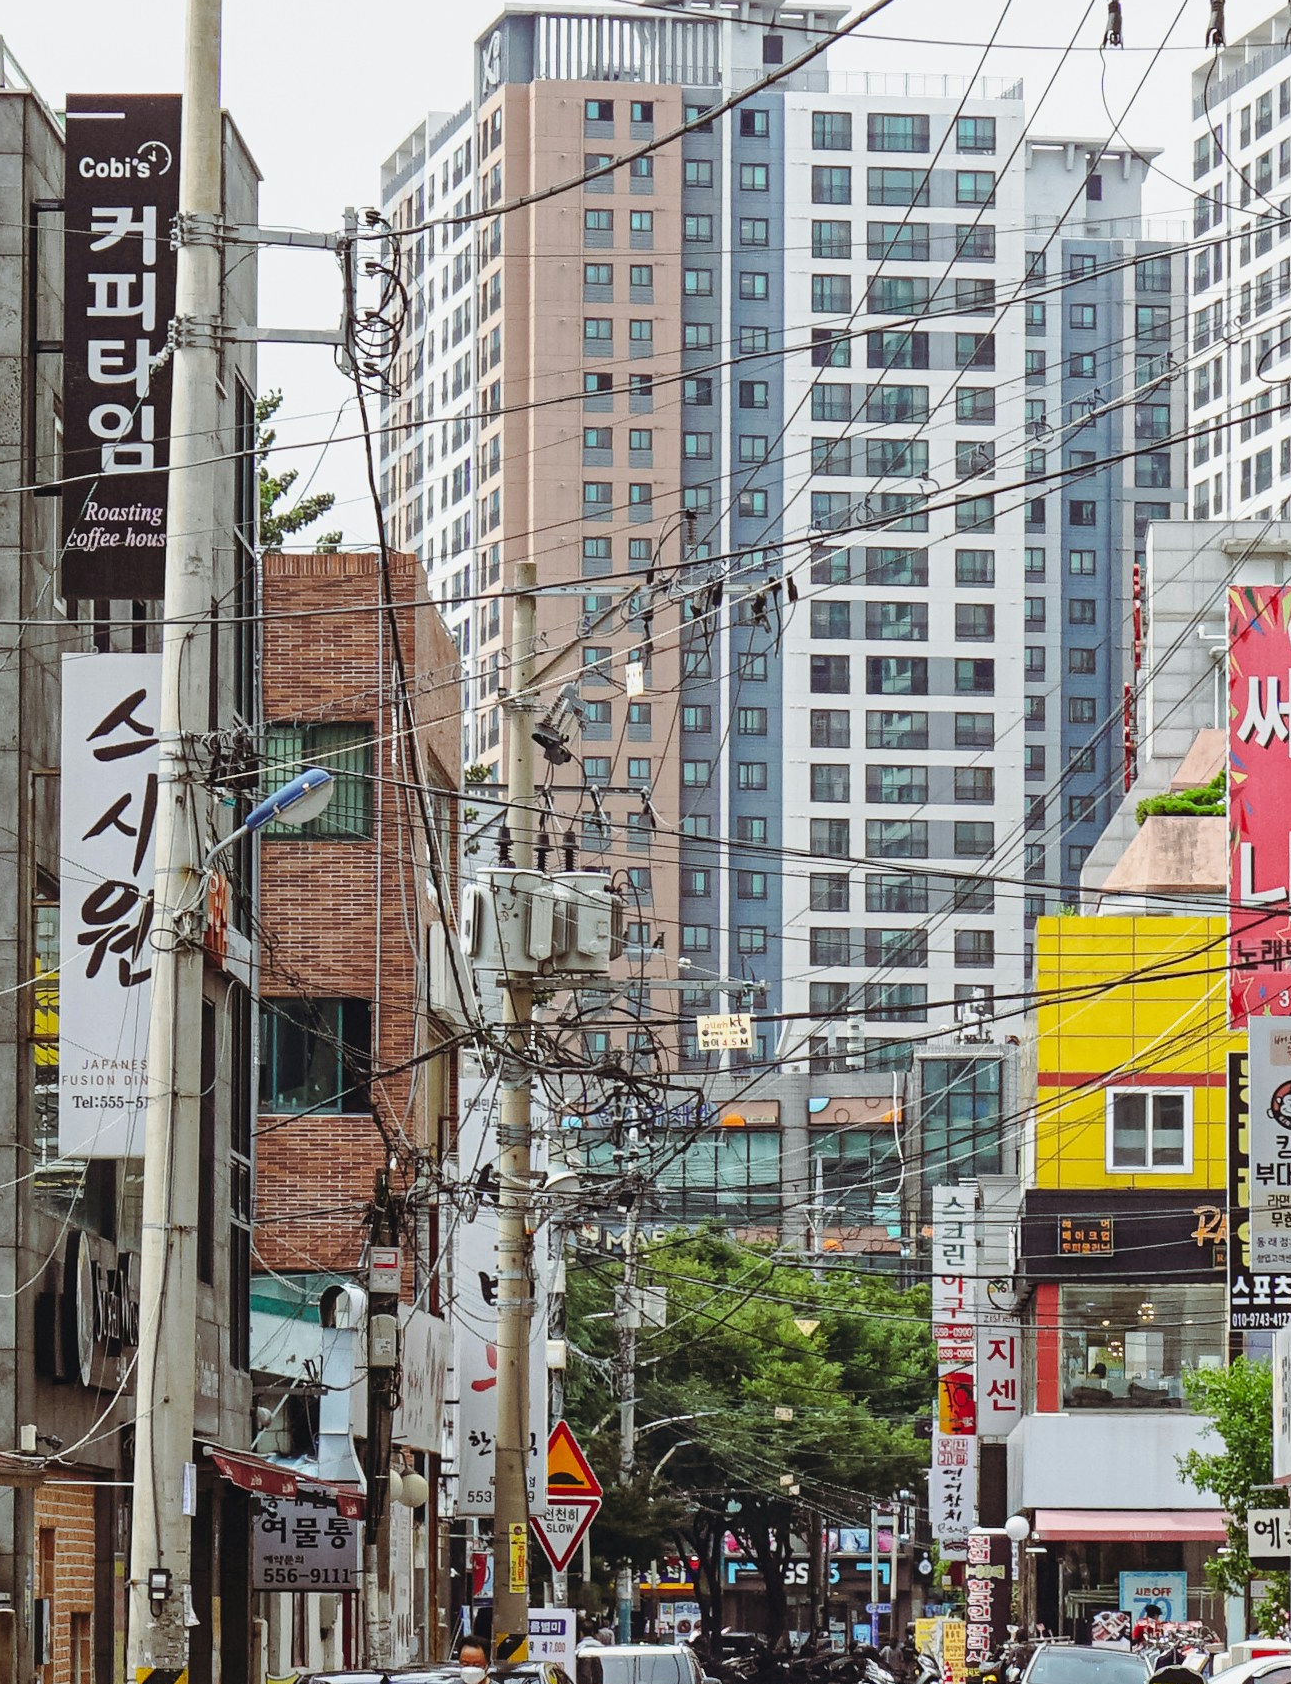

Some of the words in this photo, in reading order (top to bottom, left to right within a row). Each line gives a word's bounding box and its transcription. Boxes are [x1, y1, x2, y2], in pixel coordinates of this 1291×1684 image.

[78, 156, 150, 179] Cobi's
[87, 205, 158, 473] 커피타임
[85, 501, 163, 525] Roasting
[67, 529, 122, 552] coffee
[125, 528, 166, 548] hous
[82, 1059, 148, 1070] JAPANES
[62, 1075, 115, 1086] FUSION
[987, 1337, 1016, 1412] 지센
[262, 1517, 353, 1550] 여물통
[546, 1523, 576, 1534] SLOW
[263, 1567, 351, 1584] 556-9111
